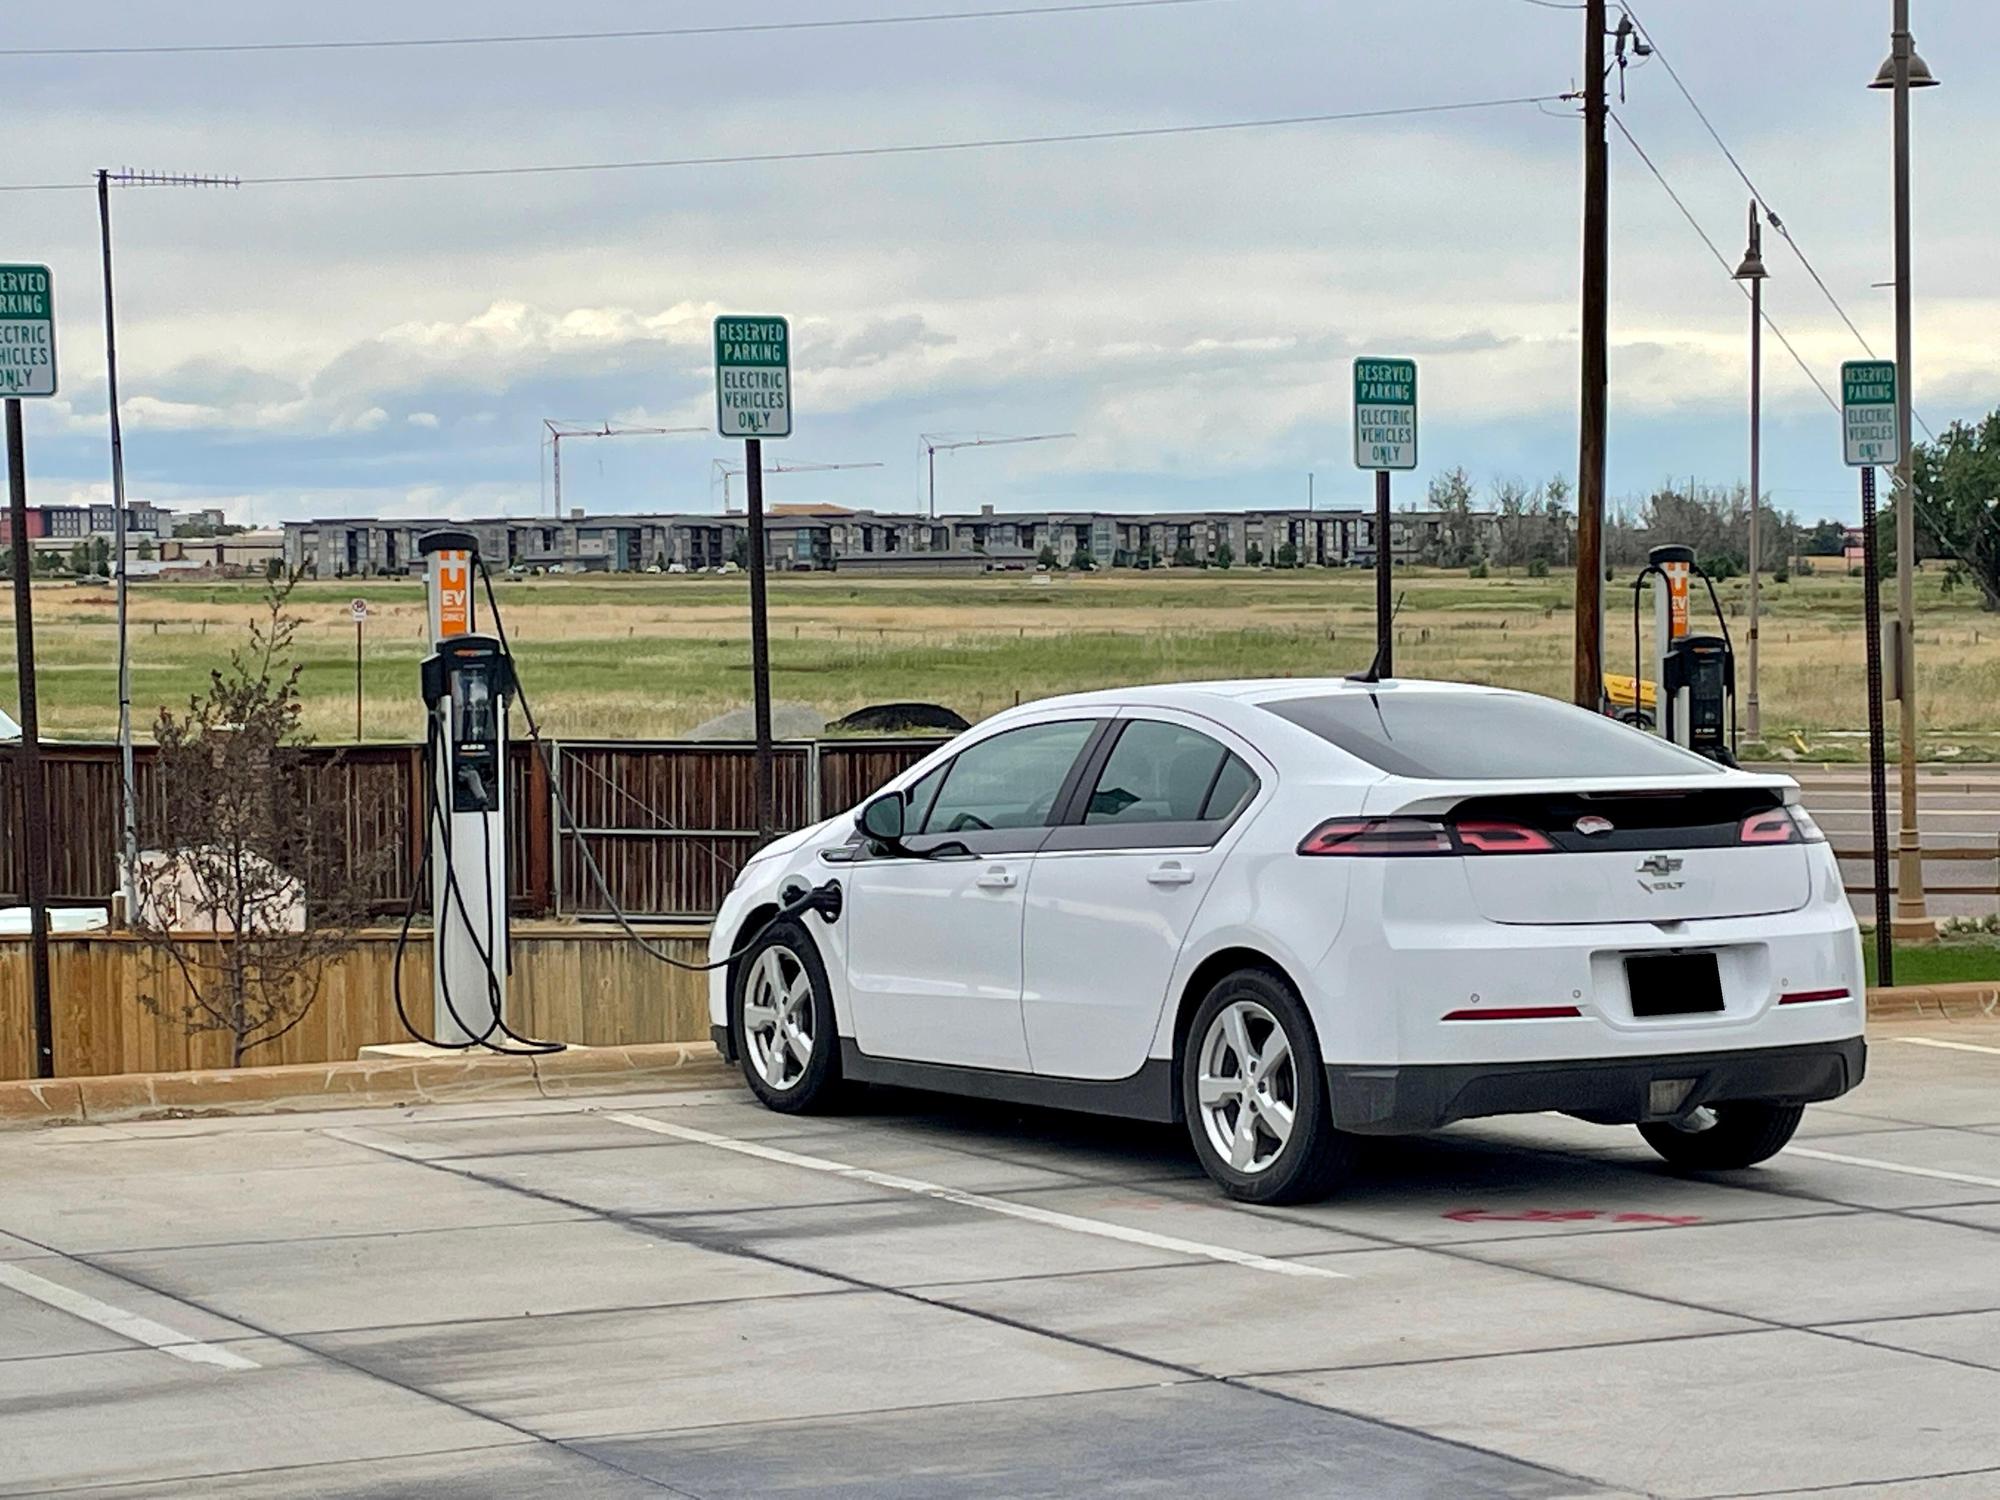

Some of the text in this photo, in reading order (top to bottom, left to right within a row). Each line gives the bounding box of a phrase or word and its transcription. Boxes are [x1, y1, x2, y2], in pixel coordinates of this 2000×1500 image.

[720, 323, 784, 341] RESERVED
[724, 342, 780, 361] PARKING
[724, 371, 782, 389] ELECTRIC
[1357, 364, 1413, 382] RESERVED
[1845, 366, 1893, 383] RESERVED
[724, 391, 784, 409] VEHICLES
[1361, 383, 1410, 400] PARKING
[1847, 383, 1891, 400] PARKING
[738, 411, 771, 428] ONLY
[1360, 408, 1411, 425] ELECTRIC
[1848, 408, 1892, 424] ELECTRIC
[1360, 427, 1412, 443] VEHICLES
[1848, 425, 1893, 441] VEHICLES
[1372, 445, 1400, 461] ONLY
[442, 589, 466, 606] EV
[1636, 879, 1687, 894] VOLT
